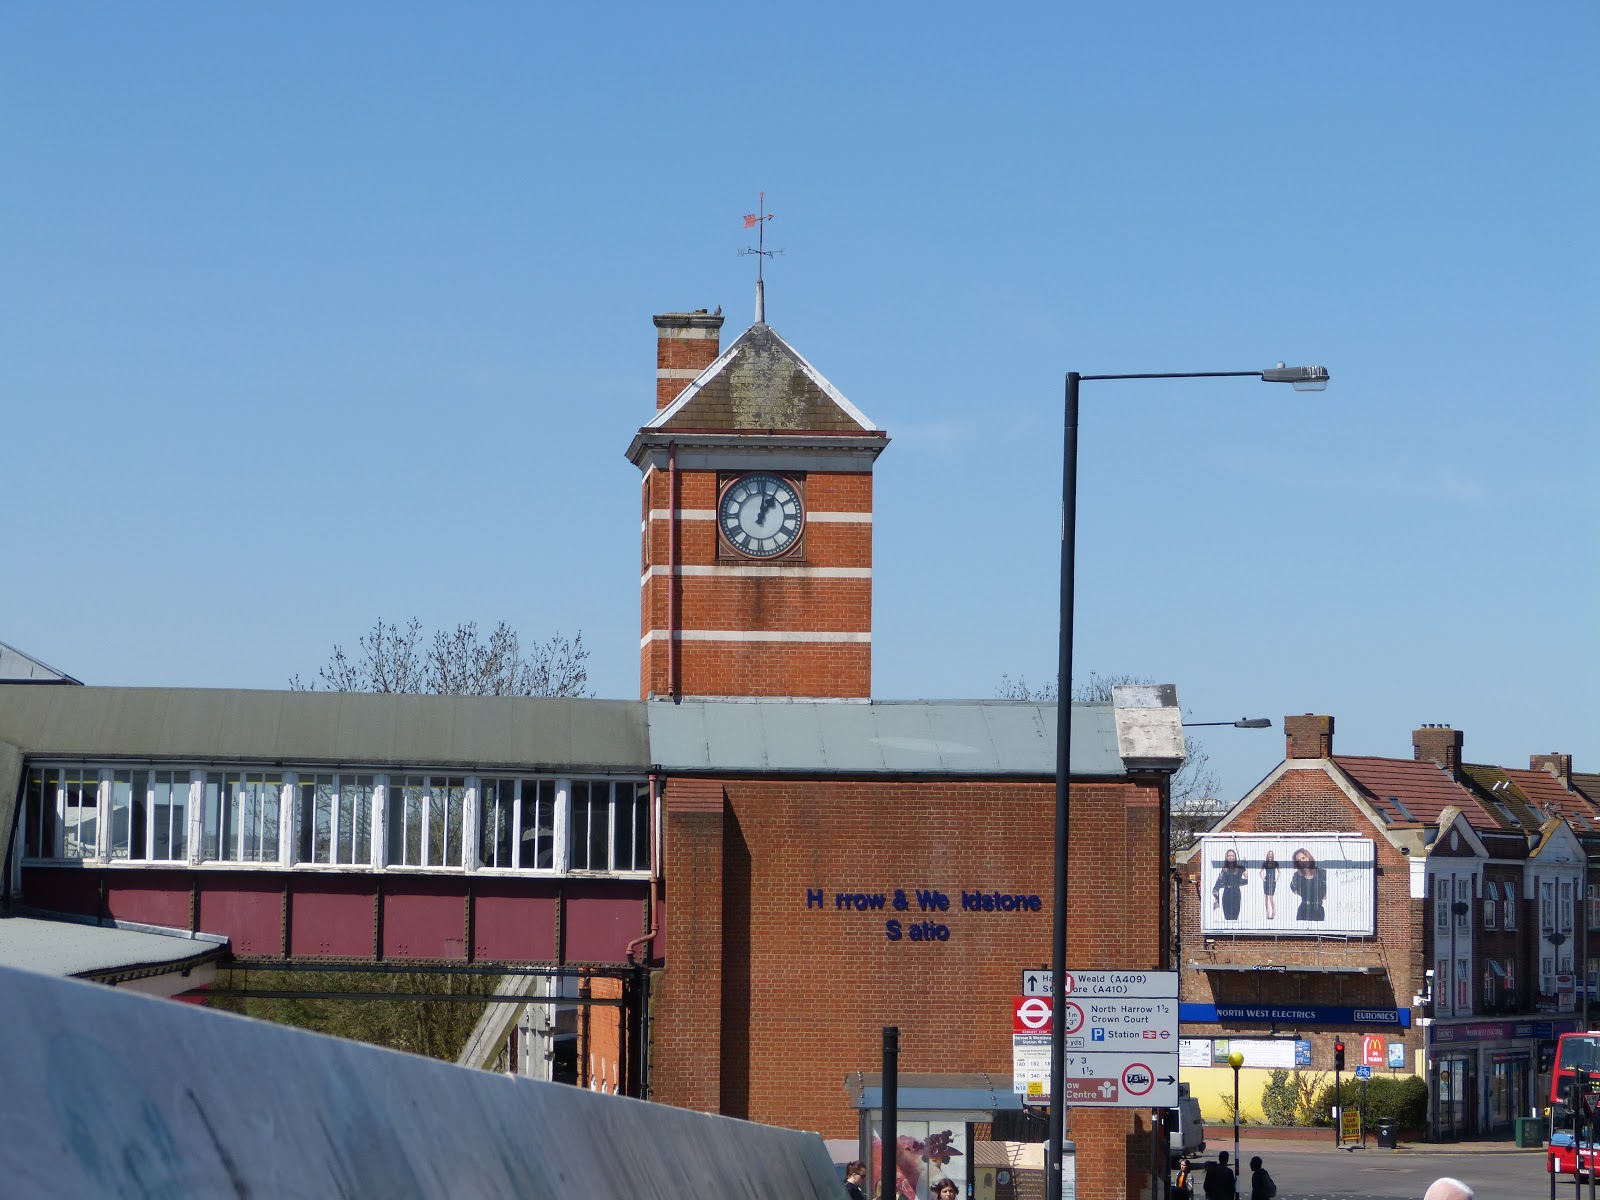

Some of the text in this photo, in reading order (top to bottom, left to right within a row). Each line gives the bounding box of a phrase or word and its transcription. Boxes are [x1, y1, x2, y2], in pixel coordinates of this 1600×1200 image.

[892, 889, 909, 911] &
[1078, 974, 1105, 983] Weald
[1110, 974, 1147, 984] (A409)
[1092, 985, 1128, 995] (A410)
[1091, 1004, 1117, 1014] North
[1121, 1005, 1153, 1014] Harrow
[1216, 1009, 1316, 1019] NORTH WEST ELECTRICS
[1091, 1015, 1149, 1024] Crown Court
[1356, 1011, 1395, 1021] EURONICS
[1108, 1030, 1140, 1039] Station
[1081, 1057, 1087, 1065] 3
[1066, 1090, 1097, 1098] Centre
